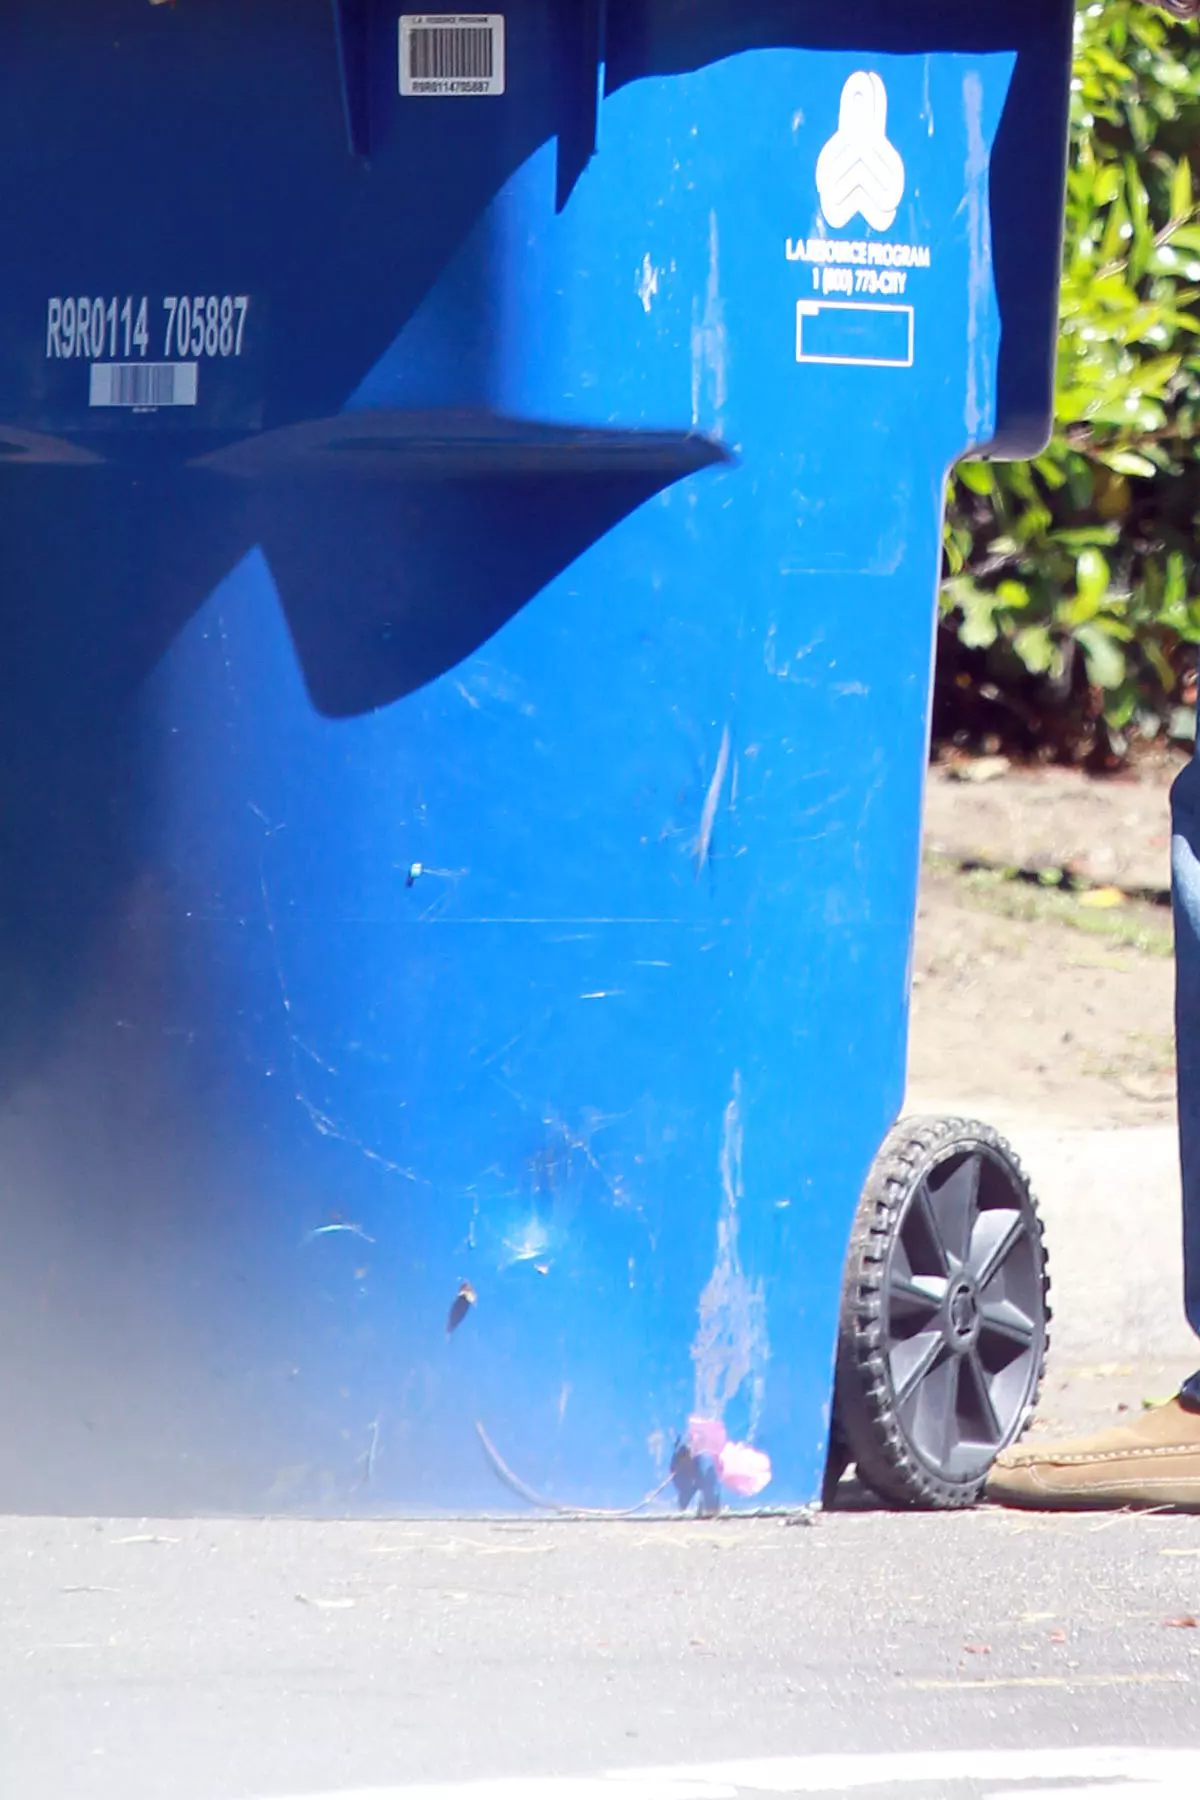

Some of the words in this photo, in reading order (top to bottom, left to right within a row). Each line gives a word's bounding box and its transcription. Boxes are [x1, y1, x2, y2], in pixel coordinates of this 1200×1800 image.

[868, 241, 931, 268] PROGRAM
[812, 267, 820, 290] 1
[46, 295, 149, 359] R9R0114
[163, 295, 250, 358] 705887
